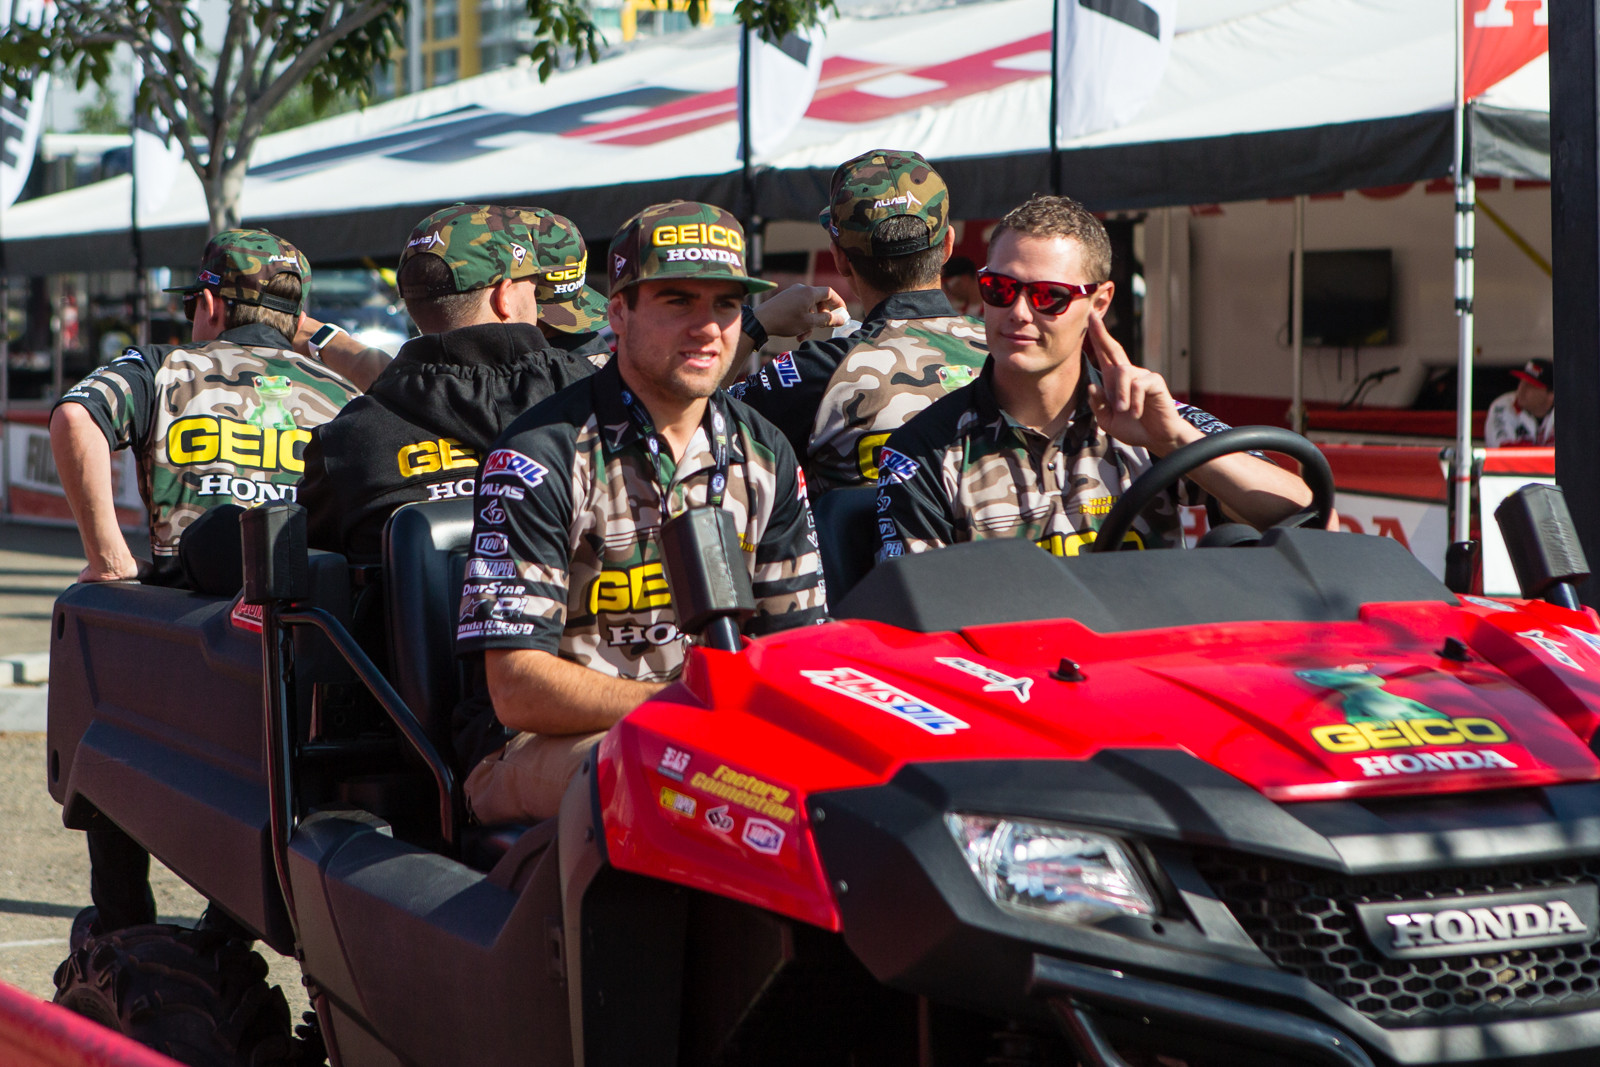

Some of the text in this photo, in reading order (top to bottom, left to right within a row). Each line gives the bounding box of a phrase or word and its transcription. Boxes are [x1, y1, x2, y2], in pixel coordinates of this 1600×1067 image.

[652, 223, 742, 252] GEICO
[666, 248, 741, 267] HONDA
[1310, 717, 1510, 754] GEICO
[1353, 749, 1519, 778] HONDA
[1386, 899, 1589, 948] HONDA
